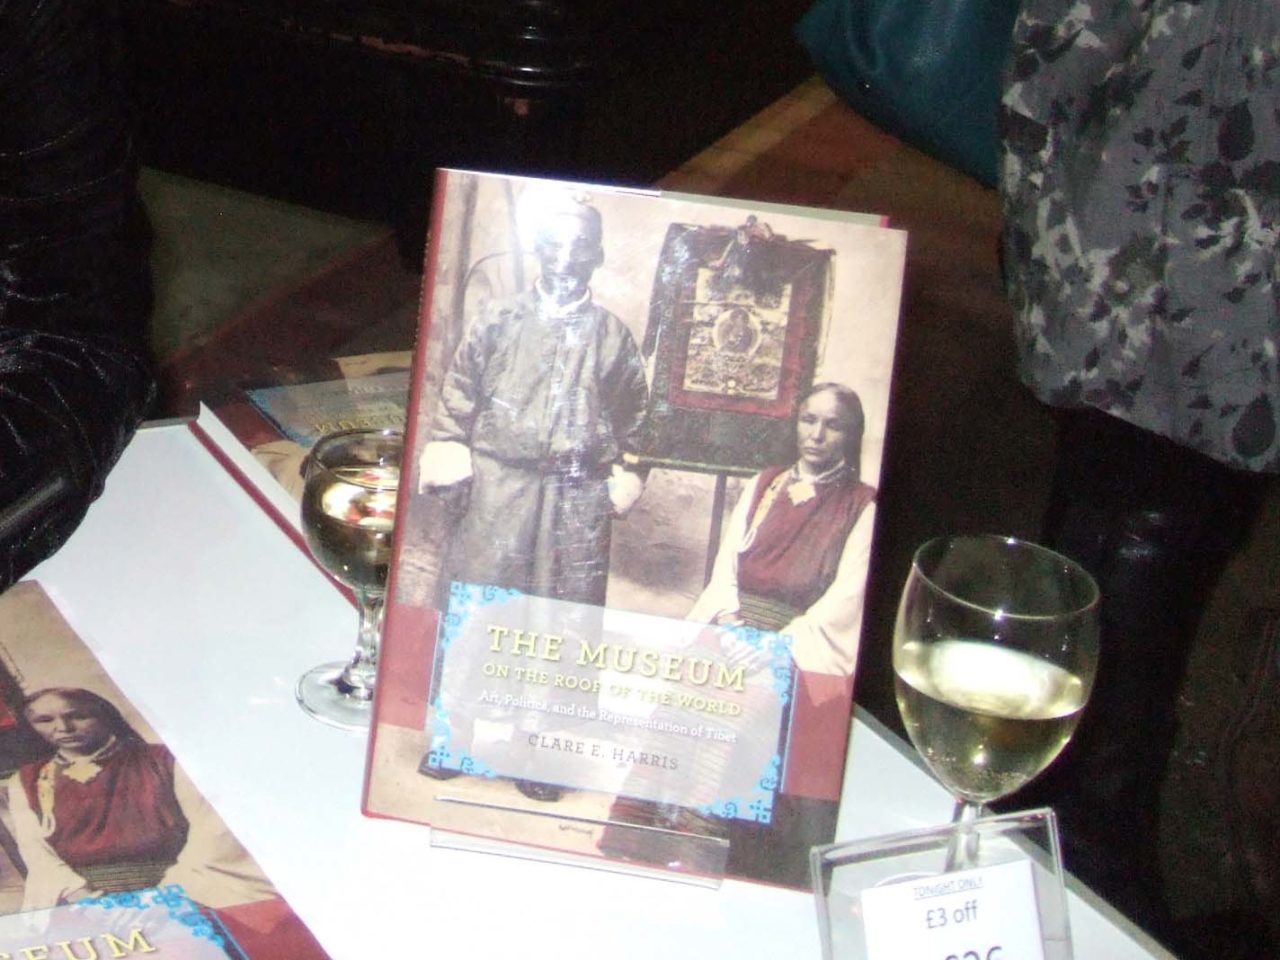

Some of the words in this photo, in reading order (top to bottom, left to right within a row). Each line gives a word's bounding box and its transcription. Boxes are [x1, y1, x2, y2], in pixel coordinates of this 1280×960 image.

[487, 623, 564, 662] THE
[575, 639, 748, 693] MUSEUM
[482, 662, 510, 678] ON
[514, 666, 550, 685] THE
[554, 673, 602, 694] ROOF
[638, 687, 673, 706] THE
[677, 692, 743, 717] WORLD
[553, 702, 575, 717] and
[578, 706, 597, 720] the
[598, 707, 688, 735] Representation
[690, 723, 703, 737] of
[704, 726, 737, 743] Tibet
[528, 733, 585, 755] CLARE
[591, 743, 606, 759] E.
[612, 747, 680, 771] HARRIS
[926, 907, 949, 929] £3
[953, 899, 979, 924] off
